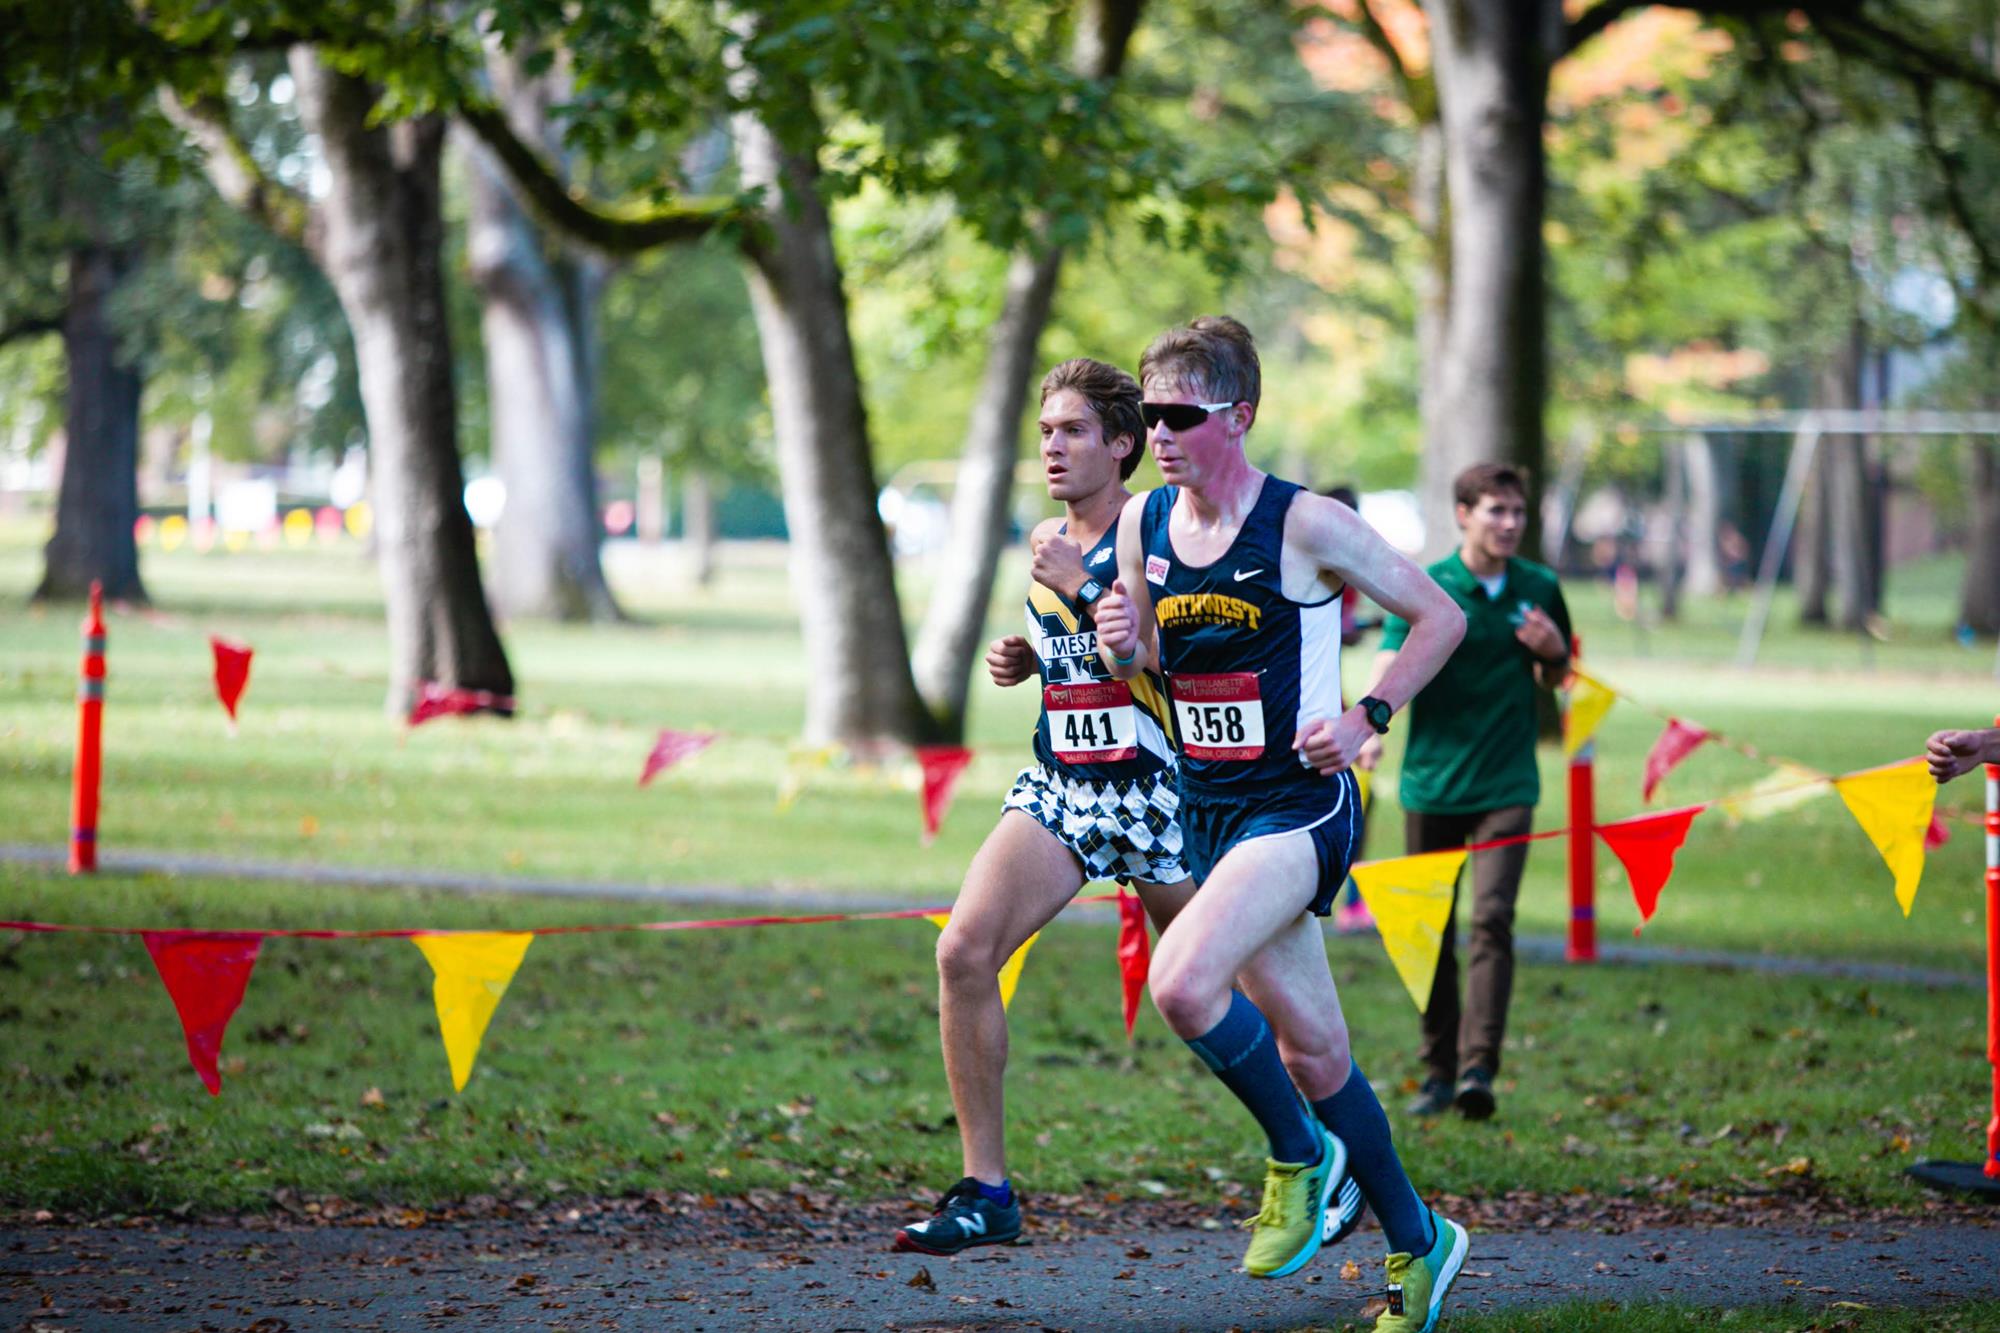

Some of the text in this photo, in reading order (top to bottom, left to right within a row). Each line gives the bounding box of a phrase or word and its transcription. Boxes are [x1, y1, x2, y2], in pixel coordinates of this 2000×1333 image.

[1166, 615, 1242, 628] UNIVERSITY
[1052, 631, 1098, 657] MESA
[1065, 712, 1118, 747] 441
[1187, 706, 1245, 743] 358
